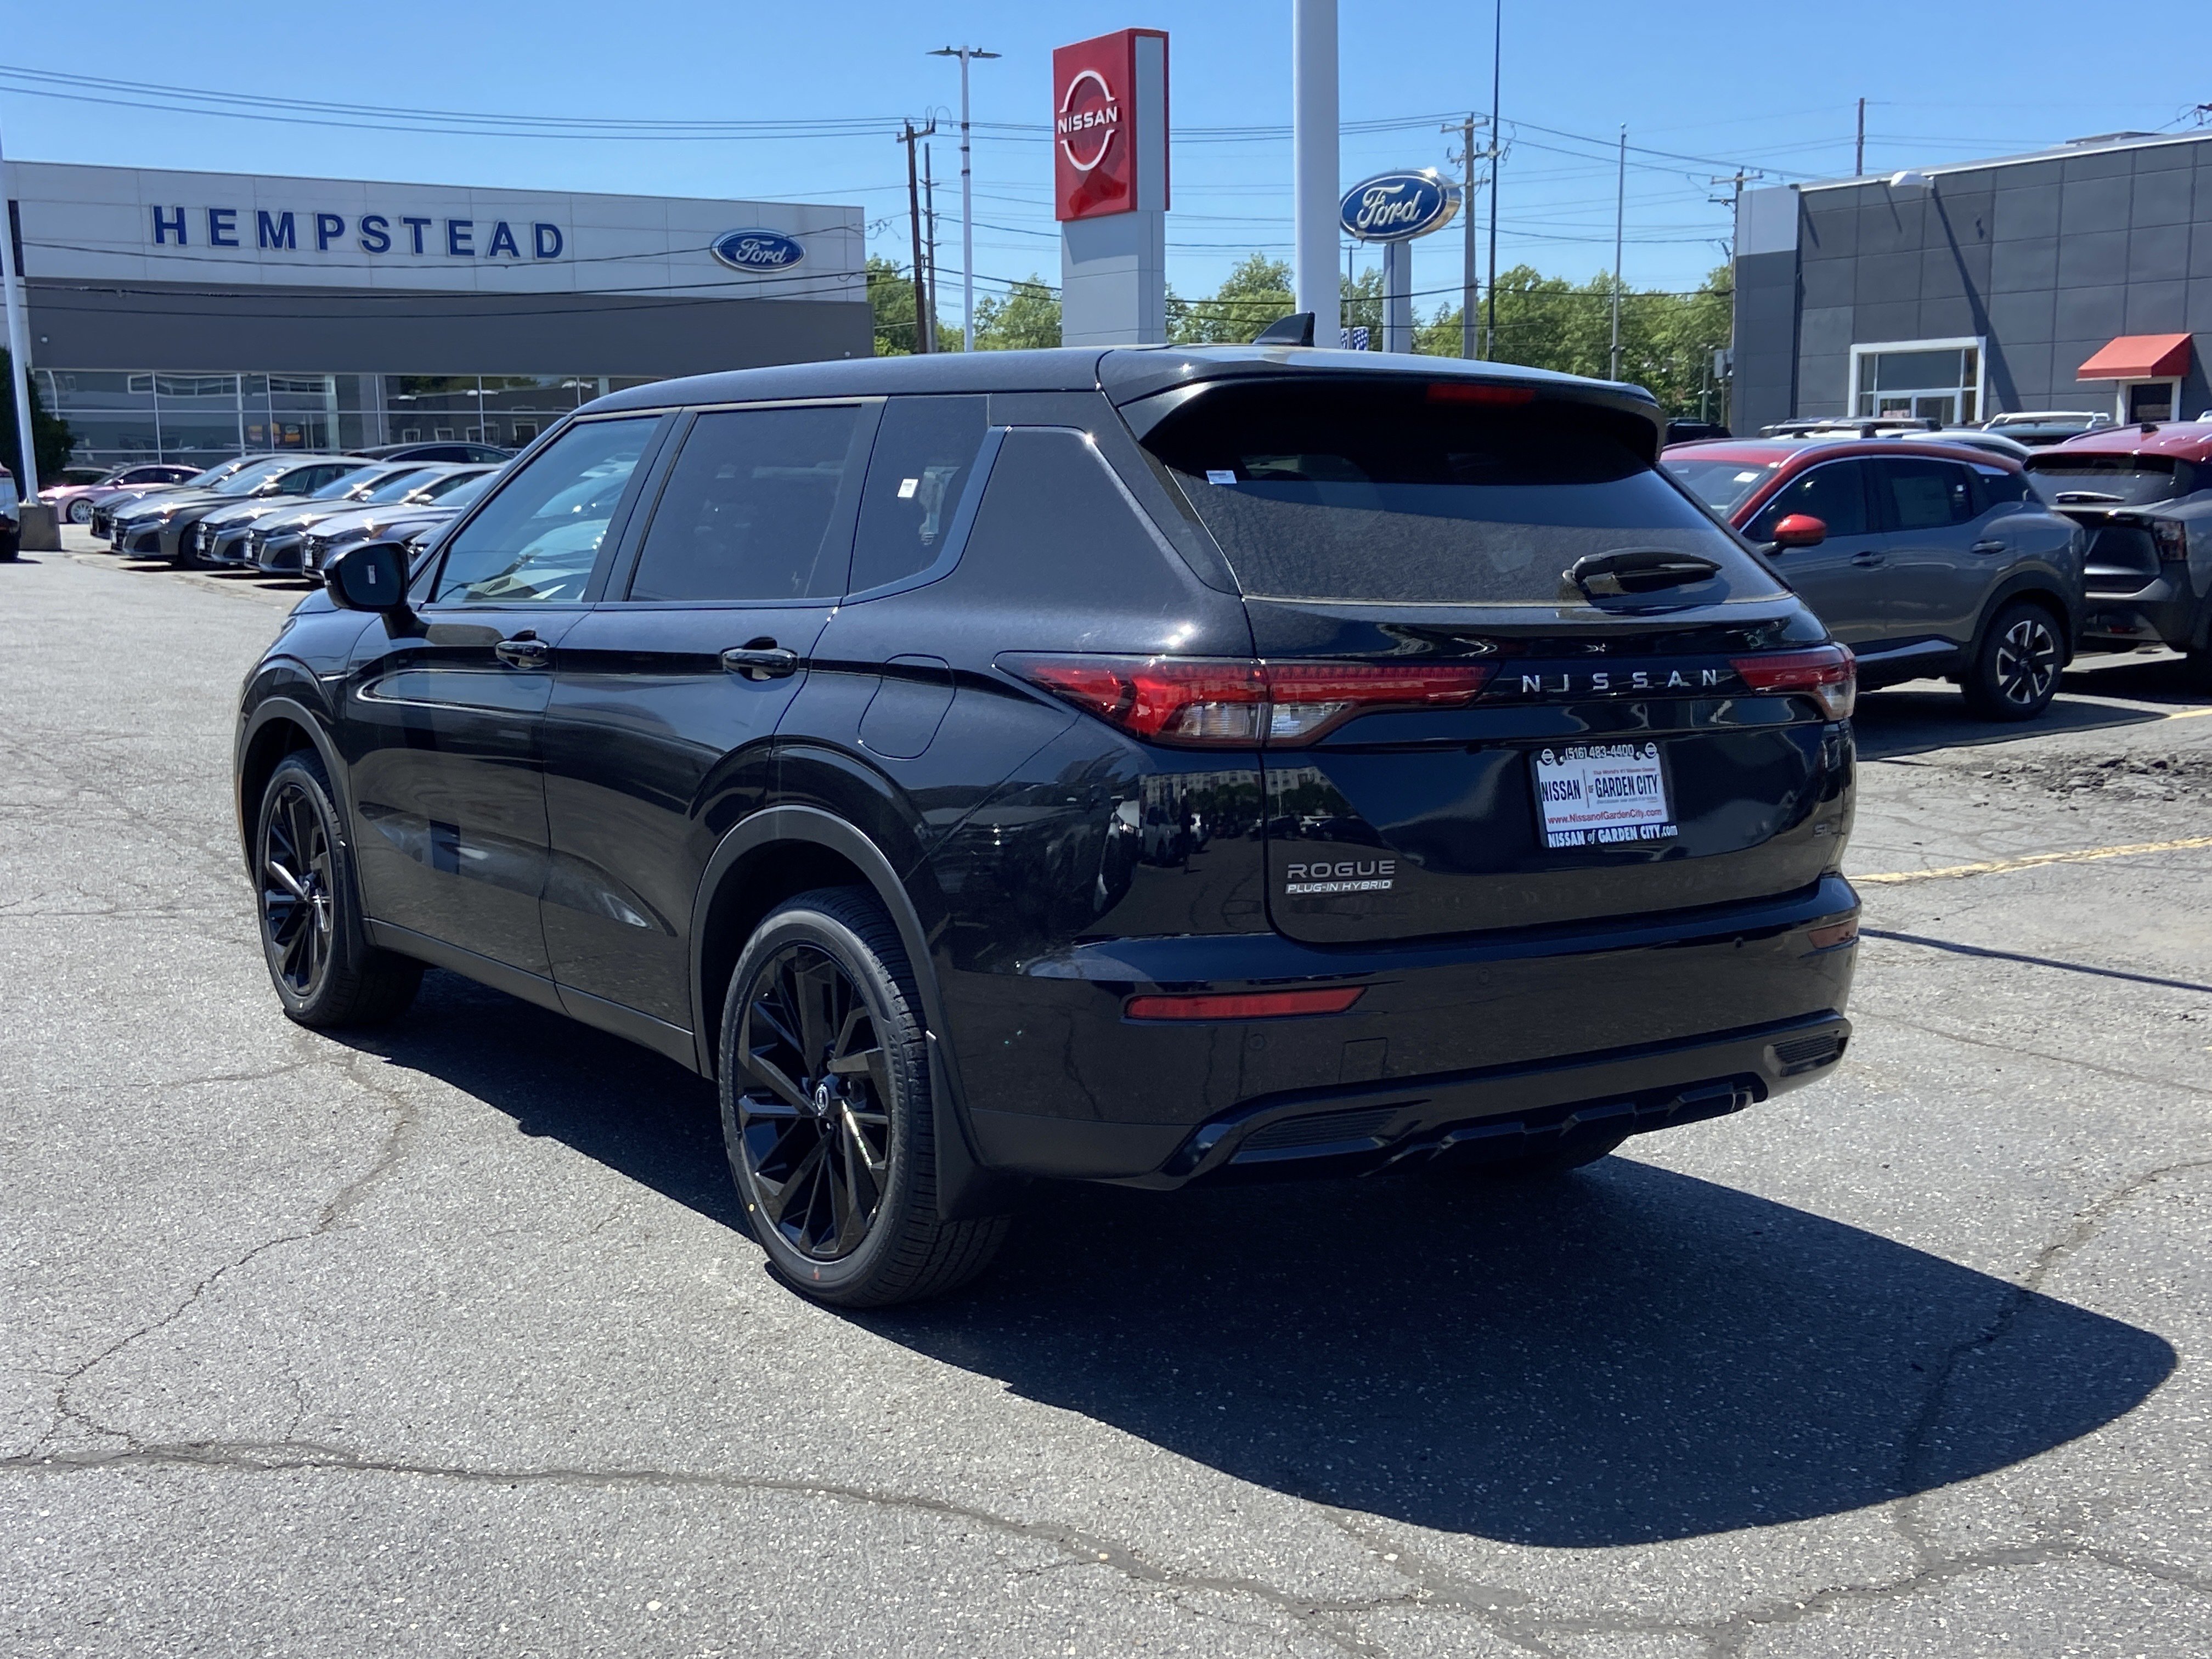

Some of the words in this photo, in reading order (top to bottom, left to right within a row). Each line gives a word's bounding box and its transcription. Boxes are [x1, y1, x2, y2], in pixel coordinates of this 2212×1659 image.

[1057, 106, 1118, 134] NISSAN
[1357, 184, 1423, 229] Ford
[153, 205, 563, 259] HEMPSTEAD
[736, 238, 787, 263] Ford
[1522, 669, 1717, 693] NISSAN
[1565, 747, 1587, 760] (516)
[1589, 744, 1634, 758] 483-4400
[1541, 779, 1581, 802] NISSAN
[1595, 775, 1635, 798] GARDEN
[1637, 774, 1658, 795] CITY
[1547, 808, 1662, 825] www.NissanofGardenCity.com
[1547, 831, 1586, 848] NISSAN
[1587, 829, 1596, 845] of
[1598, 826, 1638, 843] GARDEN
[1640, 824, 1679, 839] CITY.com
[1287, 860, 1396, 879] ROGUE
[1287, 883, 1339, 894] PLUG-IN
[1341, 879, 1391, 891] HYBRID
